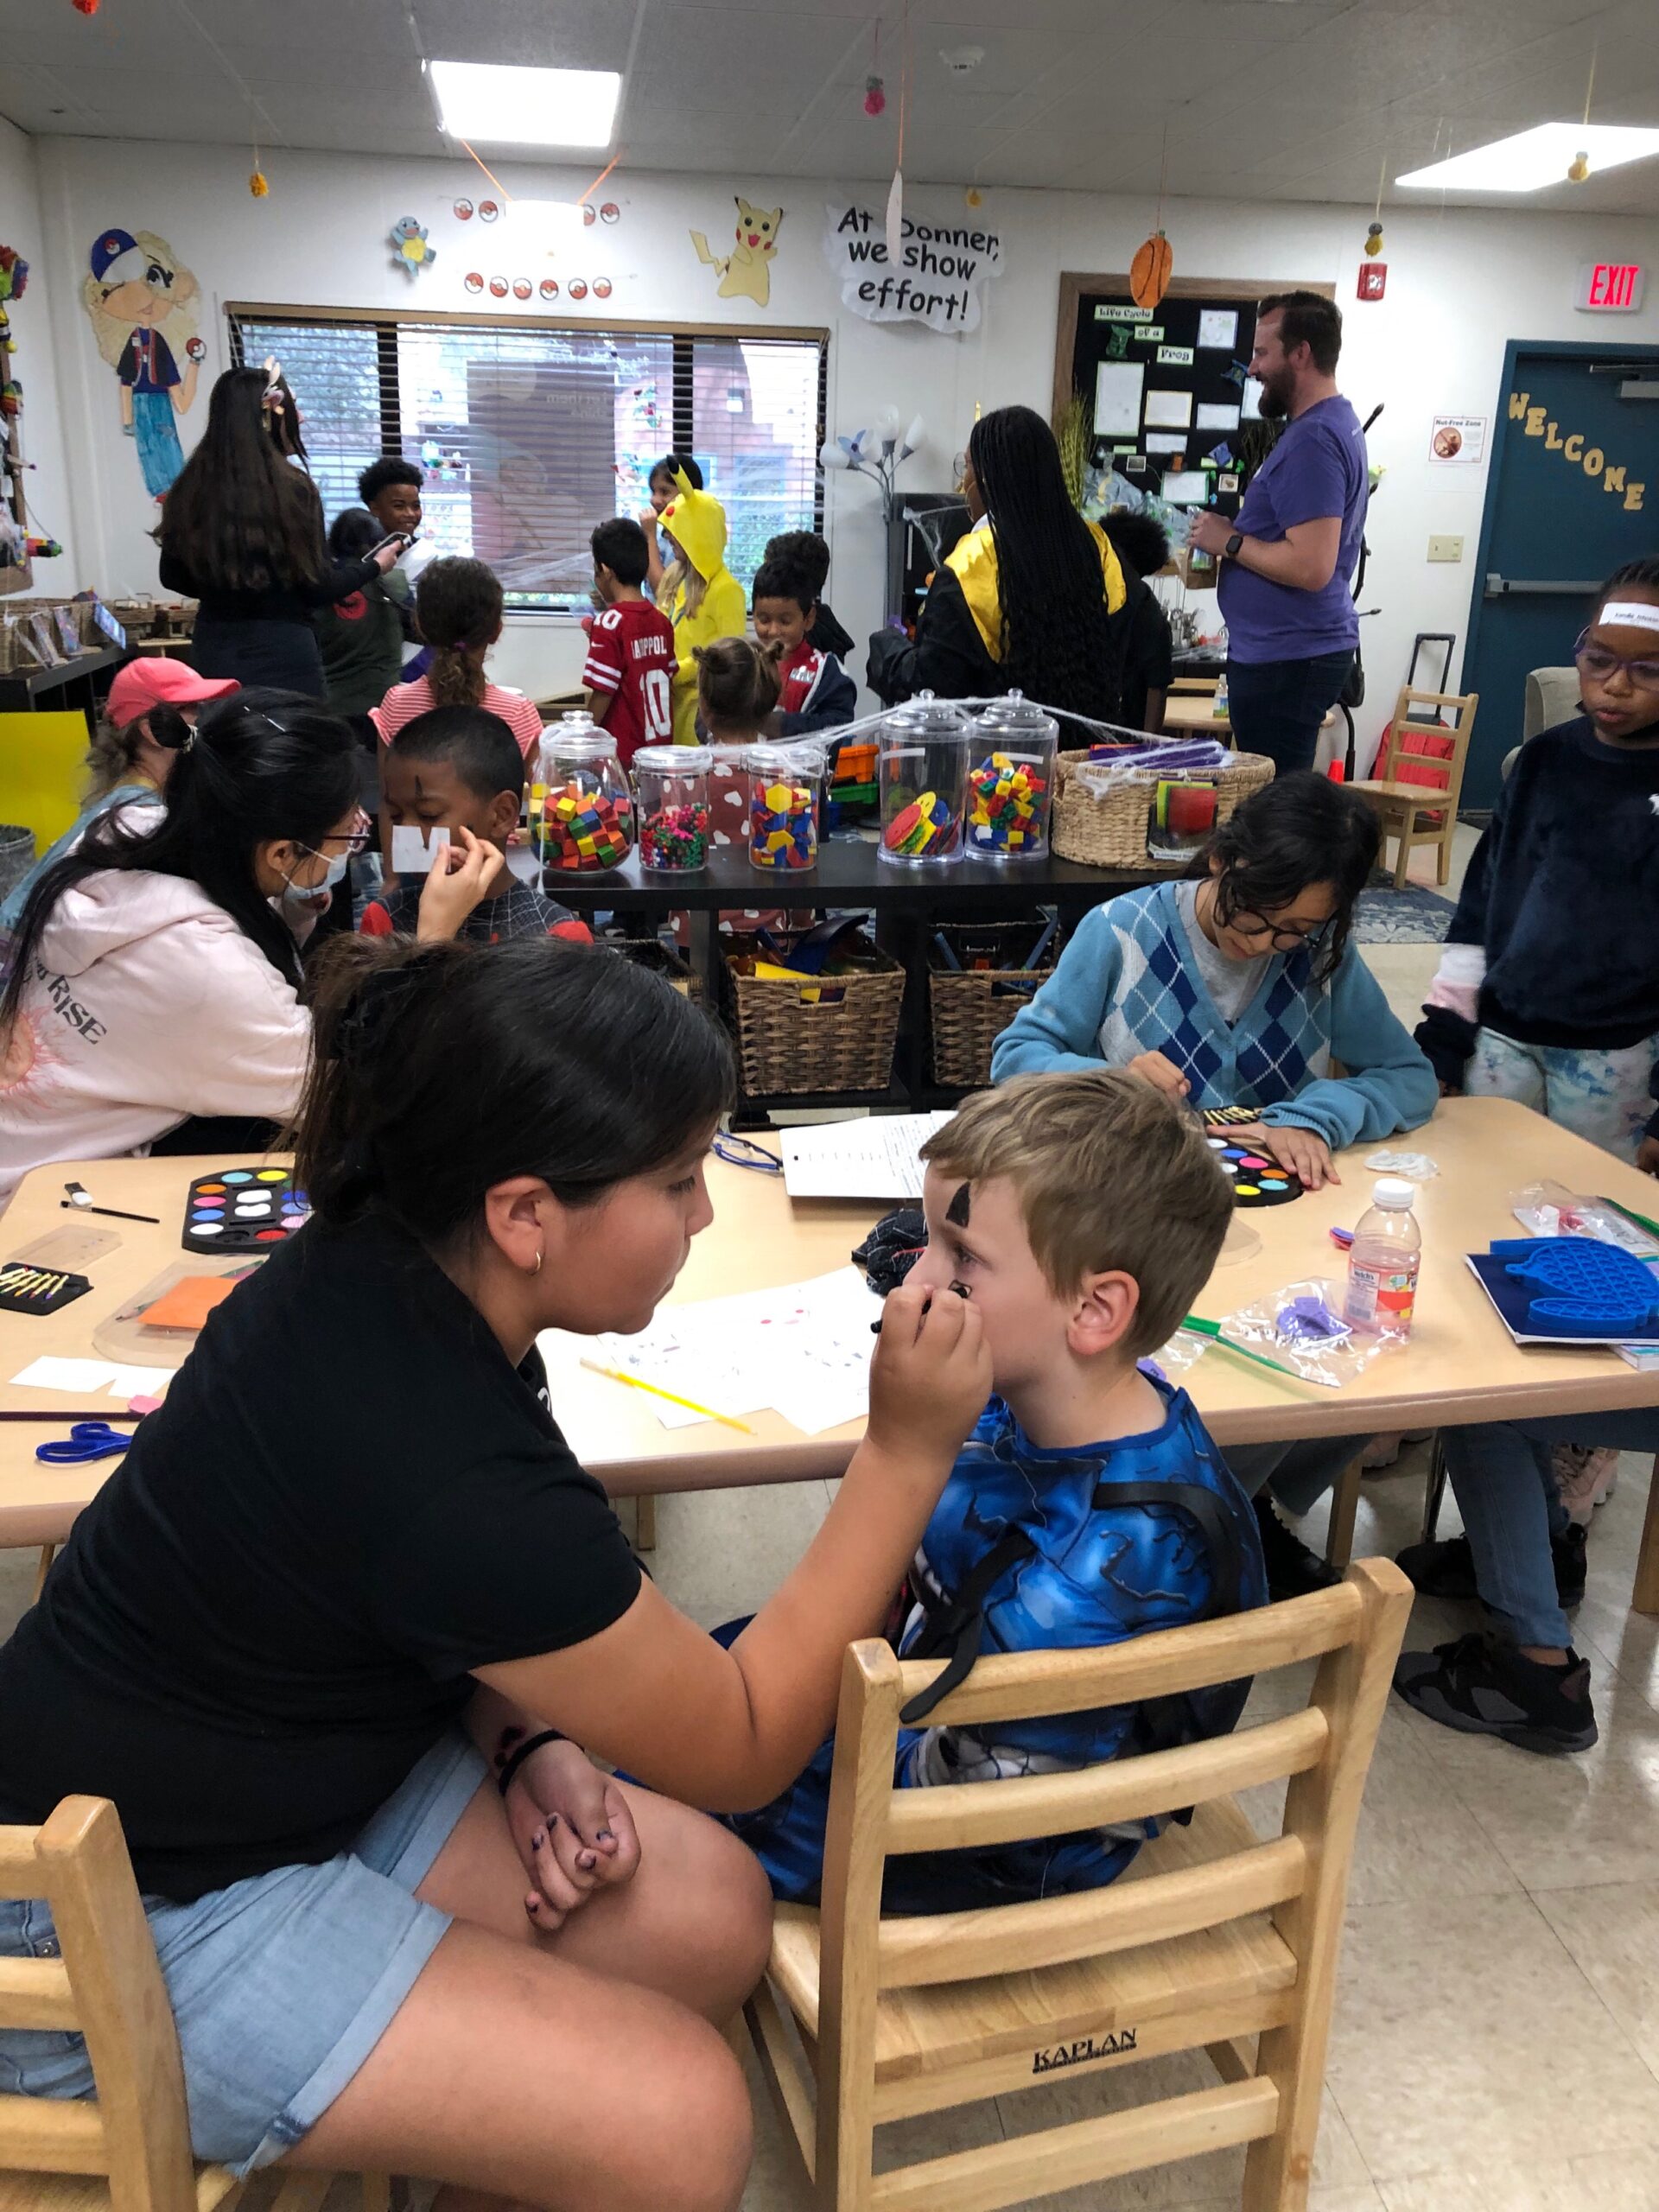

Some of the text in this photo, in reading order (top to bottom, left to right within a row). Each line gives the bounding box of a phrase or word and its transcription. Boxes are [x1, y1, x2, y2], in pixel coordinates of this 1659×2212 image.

[837, 207, 873, 233] At
[849, 240, 976, 281] we show
[858, 277, 969, 321] effort!
[1589, 264, 1639, 307] EXIT
[1508, 392, 1646, 511] WELCOME
[639, 668, 672, 742] 10
[48, 975, 108, 1045] RISE
[1033, 2028, 1137, 2072] KAPLAN
